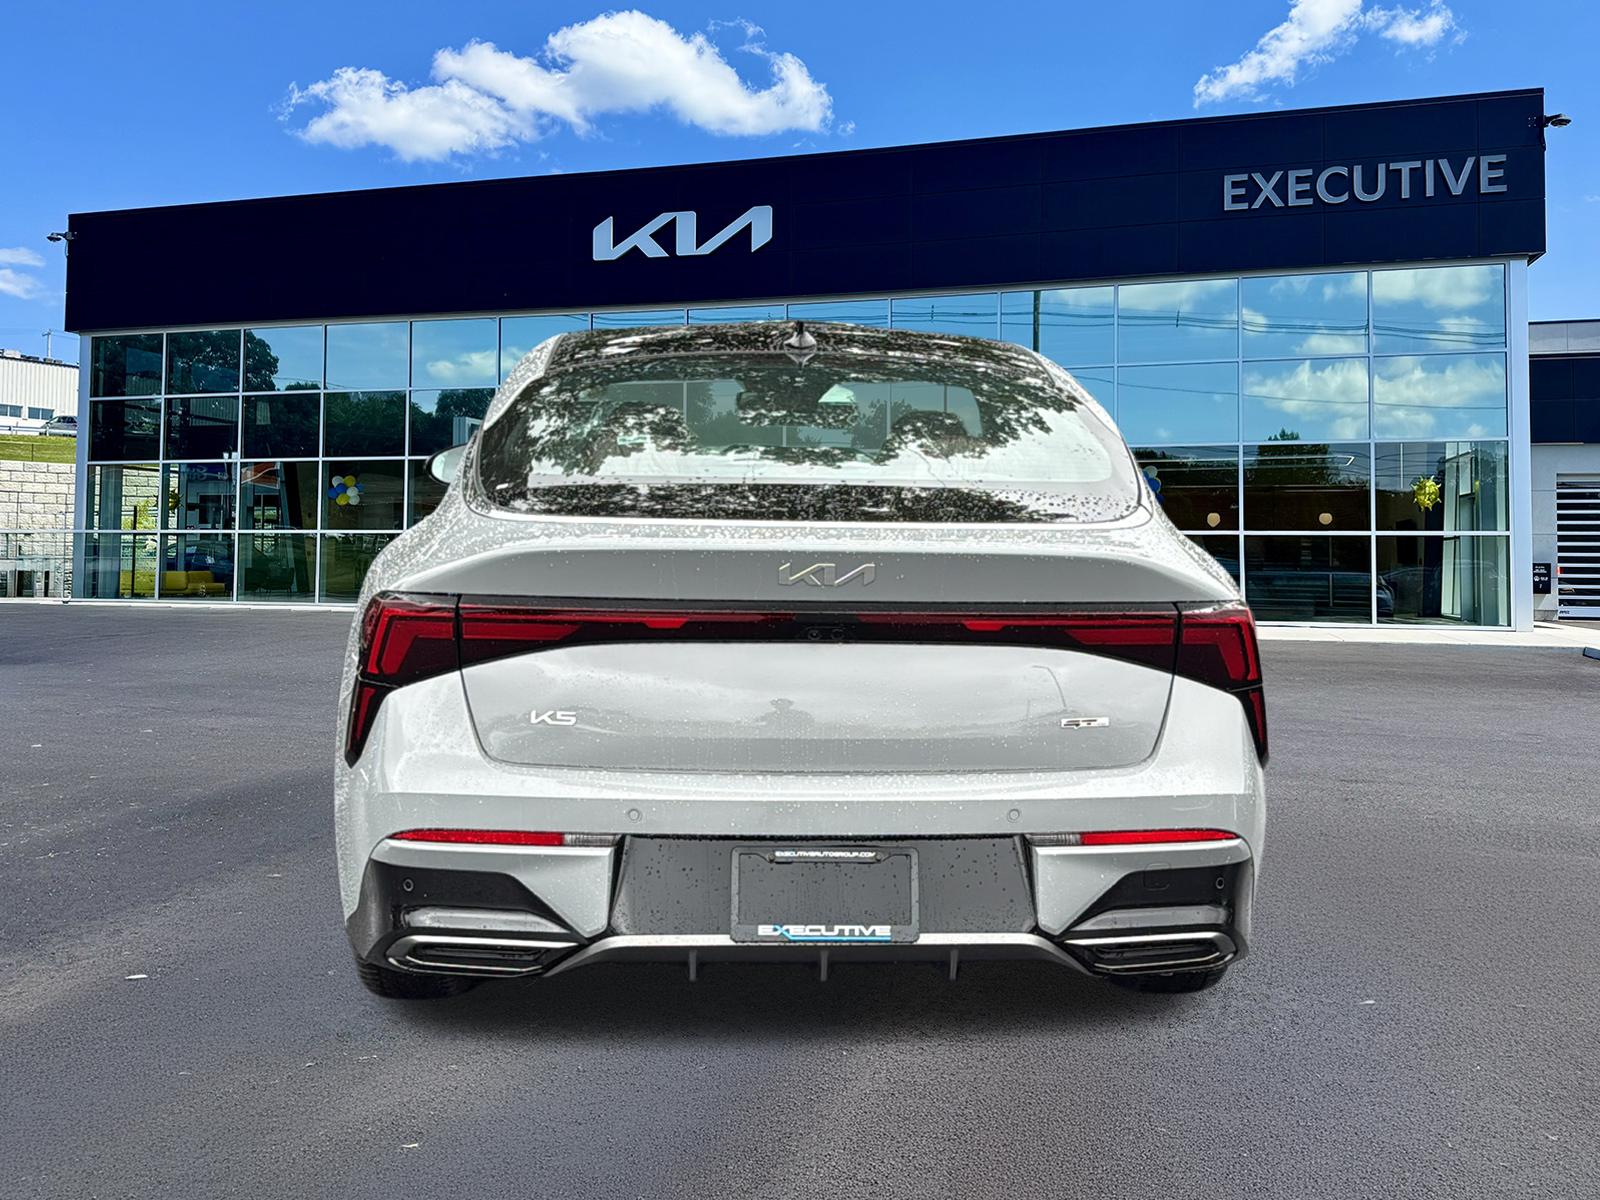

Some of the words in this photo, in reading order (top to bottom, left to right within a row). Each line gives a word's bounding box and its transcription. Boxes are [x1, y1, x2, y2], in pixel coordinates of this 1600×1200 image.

[1223, 154, 1508, 211] EXECUTIVE
[592, 205, 773, 261] KIA
[778, 562, 876, 587] KIA
[530, 709, 577, 727] K5
[757, 924, 892, 937] EXECUTIVE
